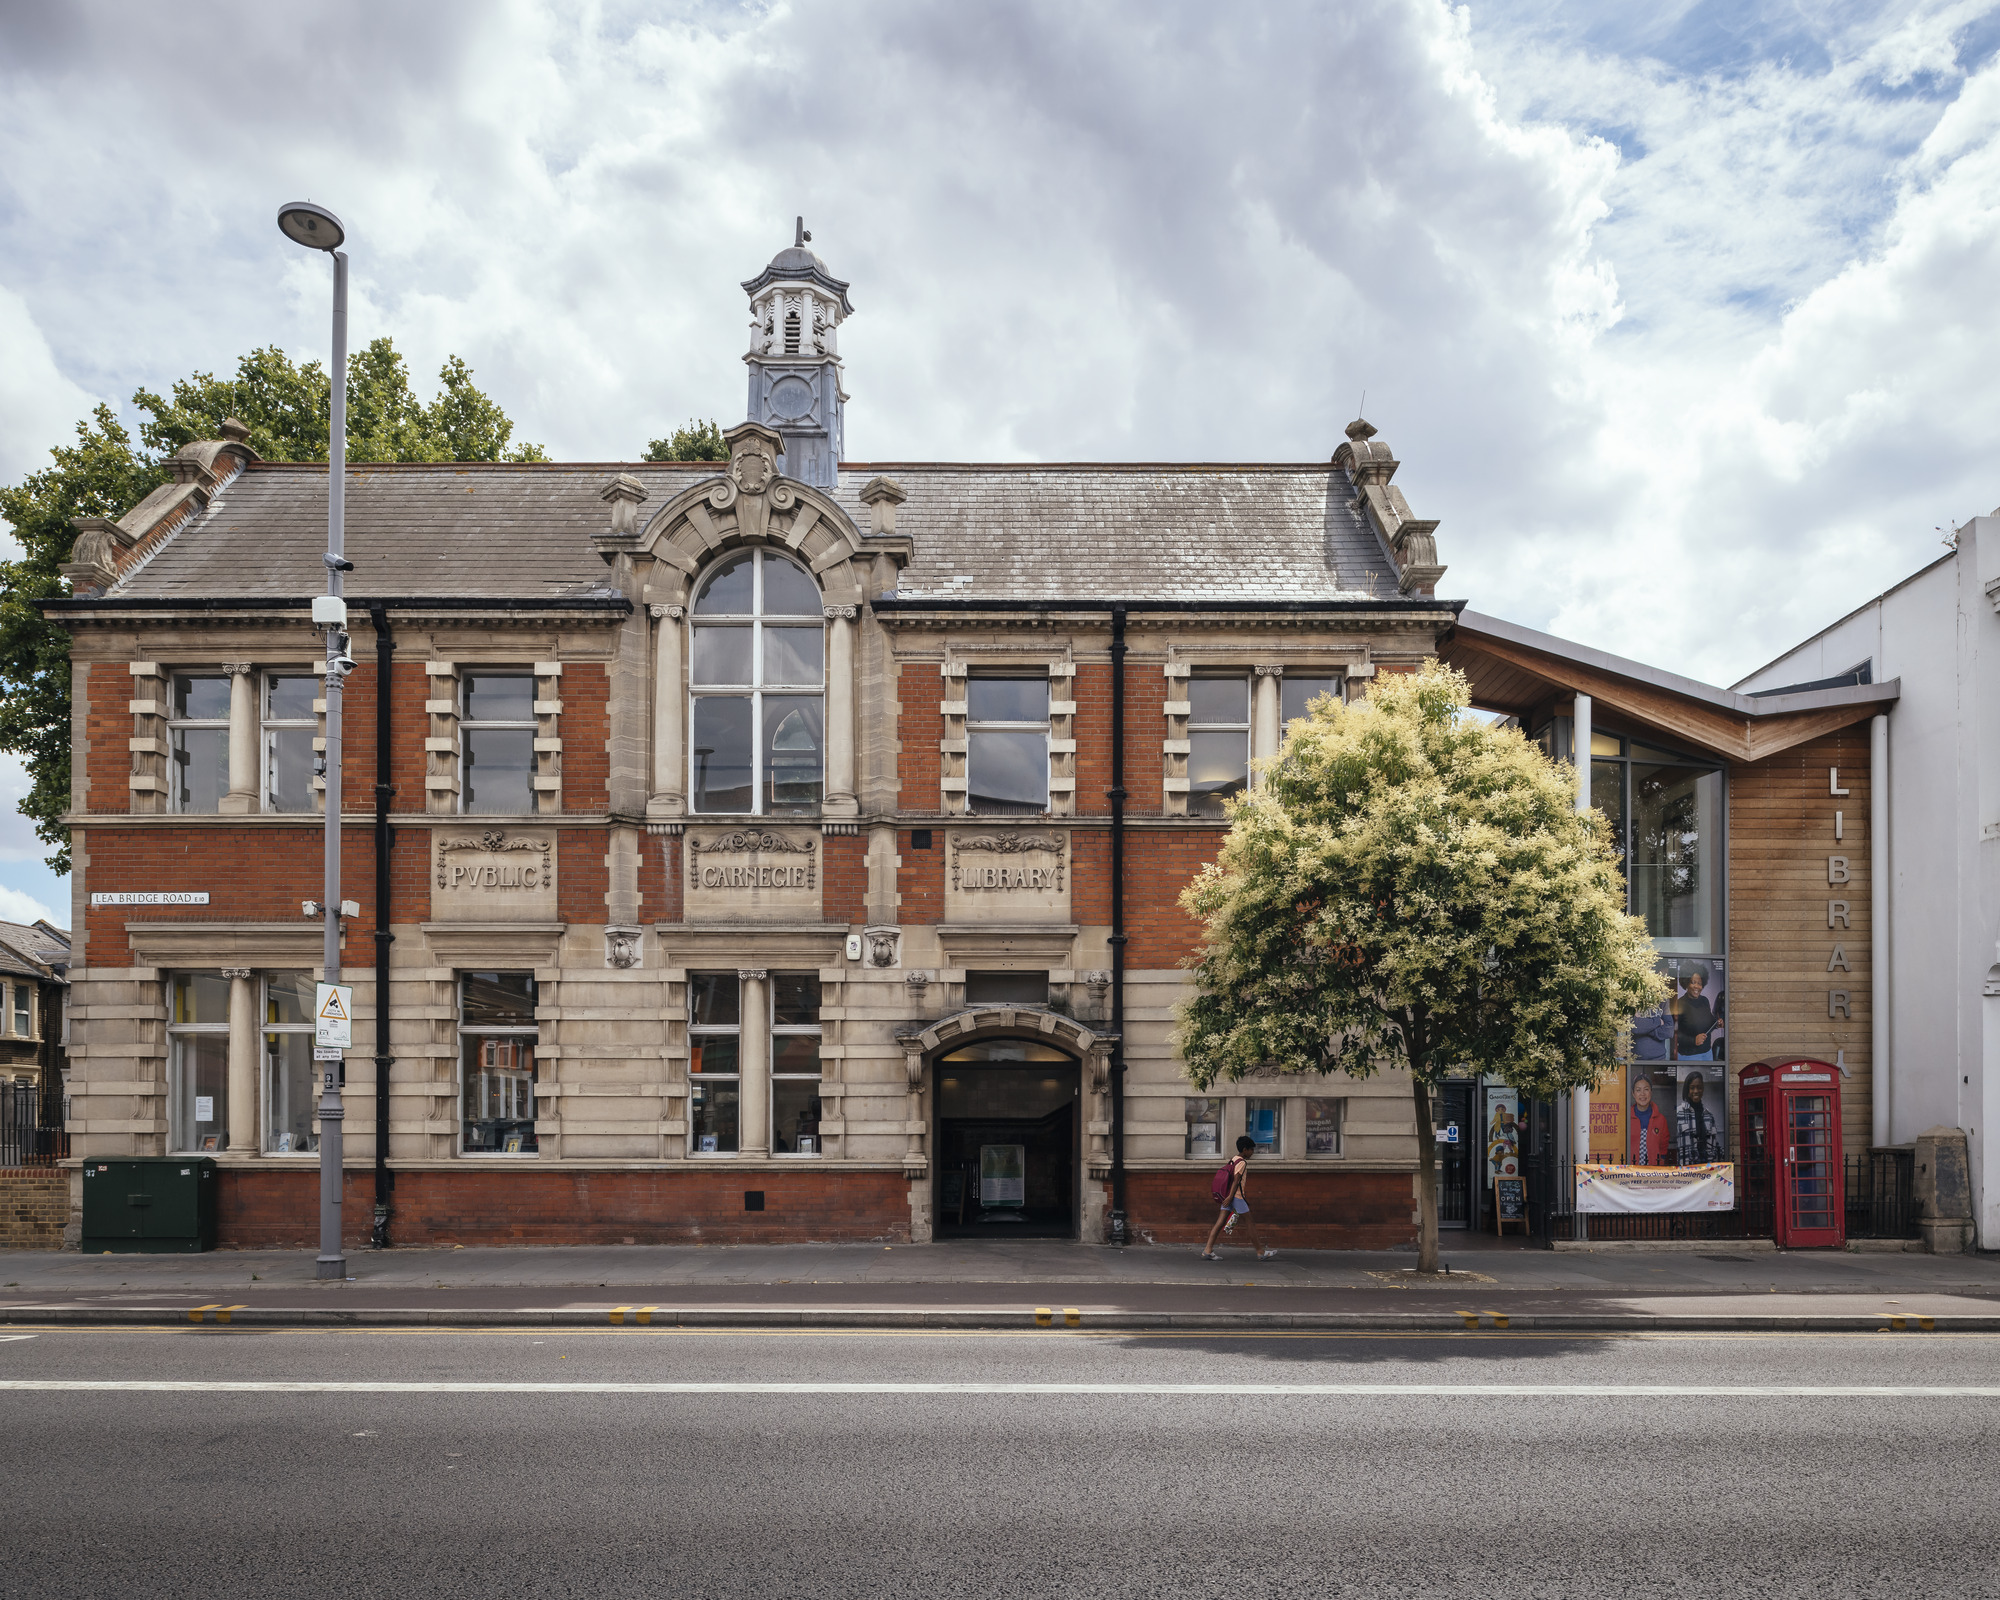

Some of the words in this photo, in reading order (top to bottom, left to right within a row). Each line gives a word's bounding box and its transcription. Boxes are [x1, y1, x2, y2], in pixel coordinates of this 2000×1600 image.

[702, 866, 805, 888] CARNEGIE
[962, 867, 1055, 888] LIBRARY
[96, 894, 114, 903] LEA
[119, 894, 158, 903] BRIDGE
[163, 894, 192, 903] ROAD
[1593, 1125, 1618, 1134] BRIDGE
[85, 1169, 96, 1177] 37
[1600, 1172, 1634, 1180] Summer
[1671, 1171, 1712, 1180] Challenge
